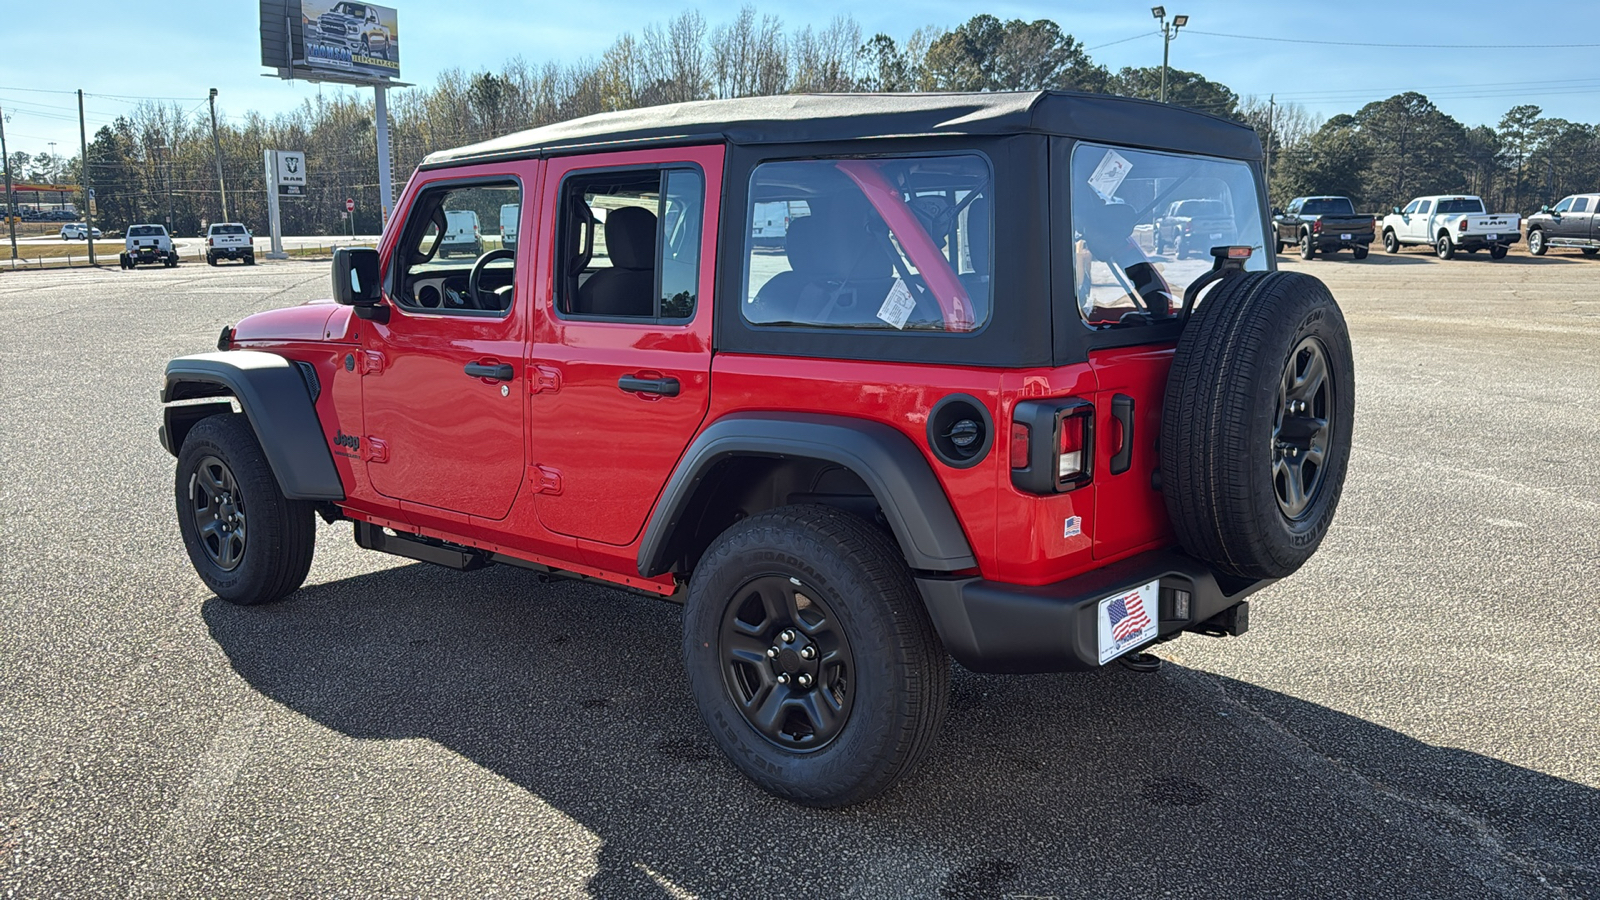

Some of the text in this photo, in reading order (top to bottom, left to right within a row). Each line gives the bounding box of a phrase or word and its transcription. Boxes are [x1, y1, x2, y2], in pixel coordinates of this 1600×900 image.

[307, 43, 352, 62] THOMSON
[333, 429, 360, 451] Jeep
[752, 551, 828, 585] ROADIAN
[713, 710, 783, 776] NEXEN
